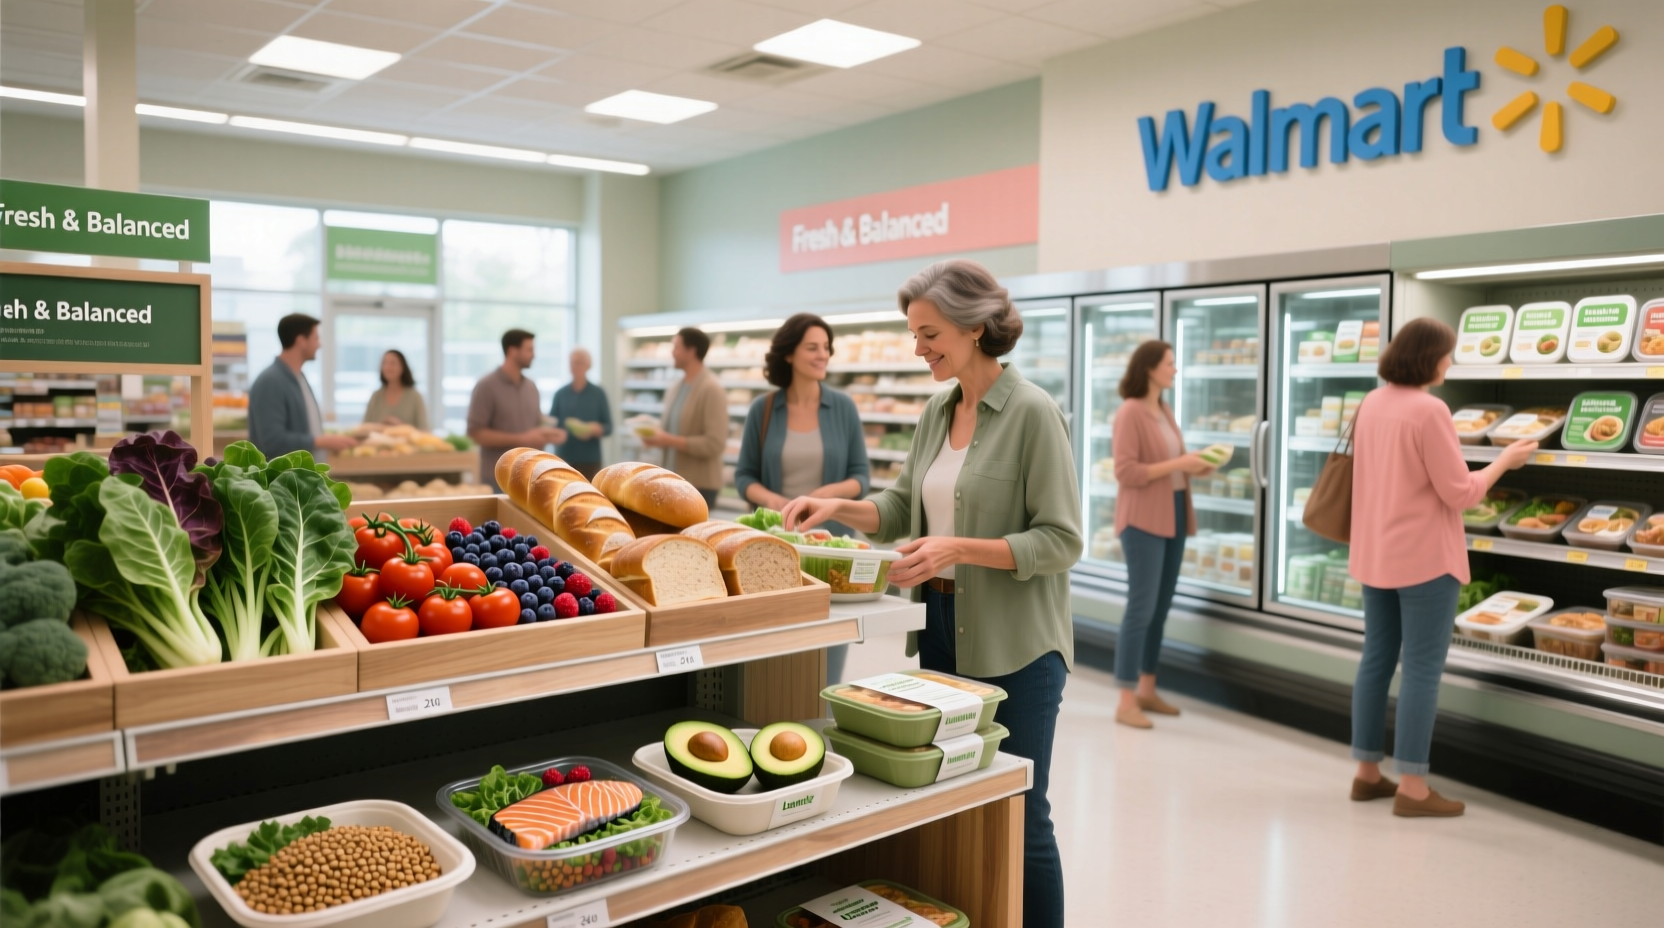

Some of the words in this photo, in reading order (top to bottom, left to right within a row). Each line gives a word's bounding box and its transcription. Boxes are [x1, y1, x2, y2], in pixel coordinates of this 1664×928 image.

[1137, 46, 1480, 192] Walmart
[62, 209, 80, 232] &
[87, 211, 190, 240] Balanced
[792, 219, 839, 253] Fresh
[840, 216, 857, 248] &
[859, 201, 949, 245] Balanced
[34, 300, 51, 320] &
[57, 301, 152, 324] Balanced
